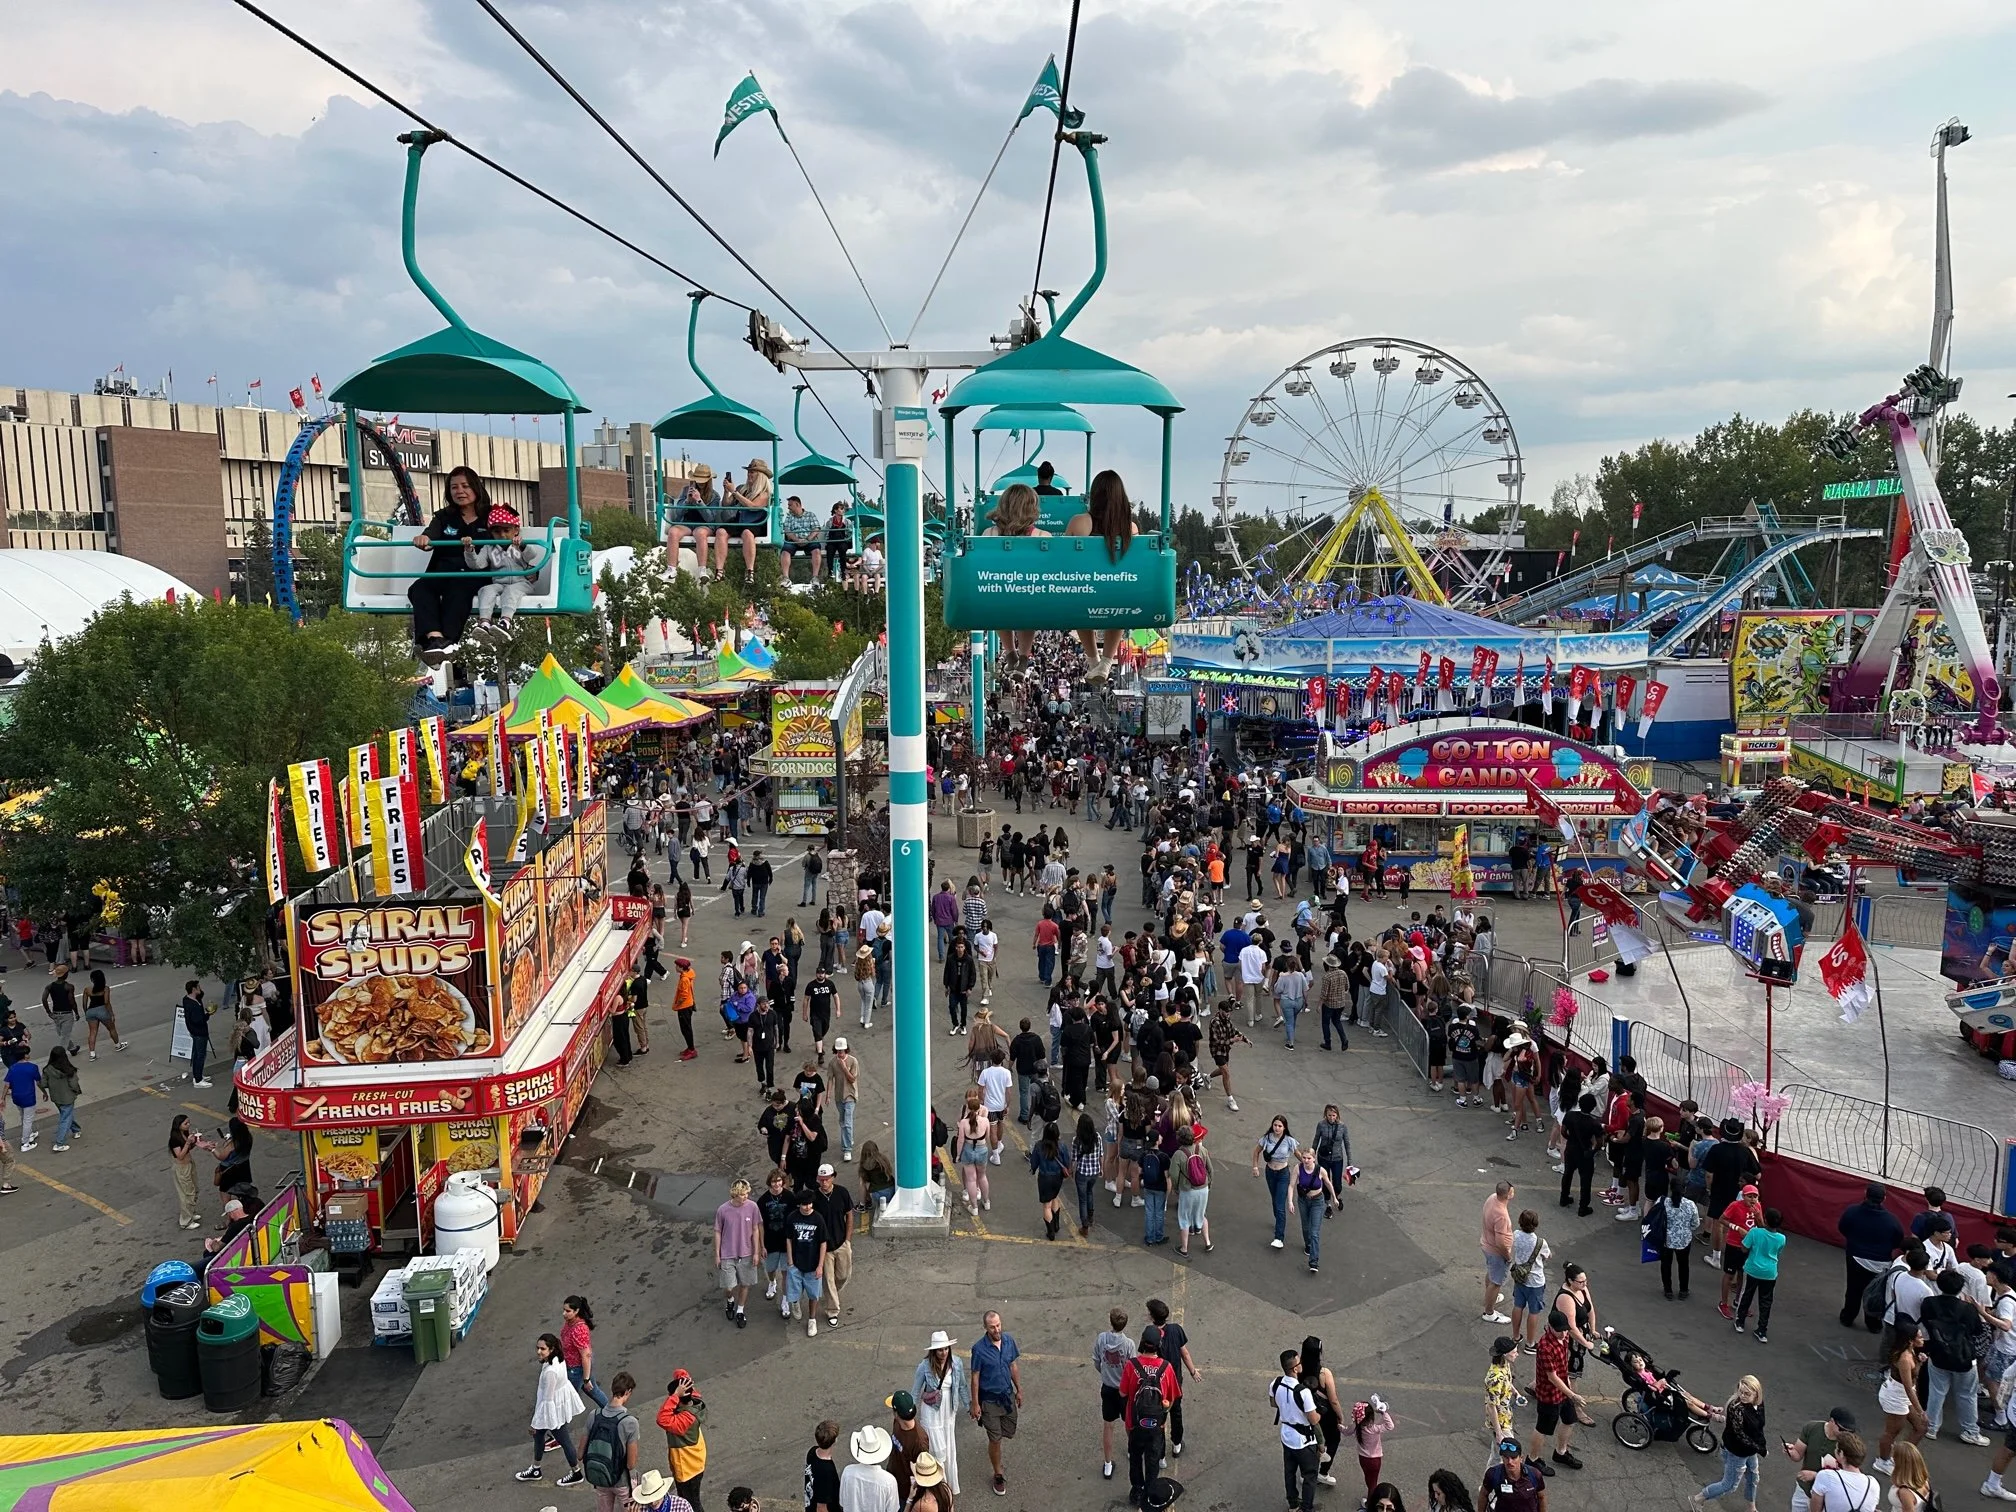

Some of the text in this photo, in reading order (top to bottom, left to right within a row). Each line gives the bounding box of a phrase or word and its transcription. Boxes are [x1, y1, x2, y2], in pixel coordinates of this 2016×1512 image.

[369, 449, 430, 469] STDIUM
[1824, 477, 1905, 499] NIAGARA FALL
[977, 571, 1138, 583] Wrangle up exclusive benefits
[977, 583, 1097, 595] with WestJet Rewards.
[1087, 607, 1131, 617] WESTJET
[1153, 614, 1167, 622] 91
[777, 705, 809, 721] CORN
[494, 719, 503, 788] FRIES
[581, 721, 590, 792] FRIES
[1432, 740, 1551, 760] COTTON
[556, 733, 568, 809] FRIES
[1438, 767, 1539, 787] CANDY
[533, 747, 546, 825] FRIES
[1307, 797, 1332, 807] COLD
[1345, 803, 1438, 814] SNO KONES
[306, 770, 326, 861] FRIES
[385, 787, 407, 884] FRIES
[900, 841, 911, 856] 6
[502, 867, 535, 922] CURLY
[309, 906, 474, 944] SPIRAL
[505, 904, 537, 960] FRIES
[317, 943, 471, 978] SPUDS
[504, 1070, 555, 1095] SPIRAL
[351, 1089, 415, 1102] FRESH-CUT
[506, 1081, 555, 1107] SPUDS
[318, 1100, 453, 1119] FRENCH FRIES
[448, 1117, 493, 1129] SPIRAL
[332, 1135, 362, 1145] FRIES
[450, 1128, 490, 1139] SPUDS
[797, 1230, 810, 1240] 14
